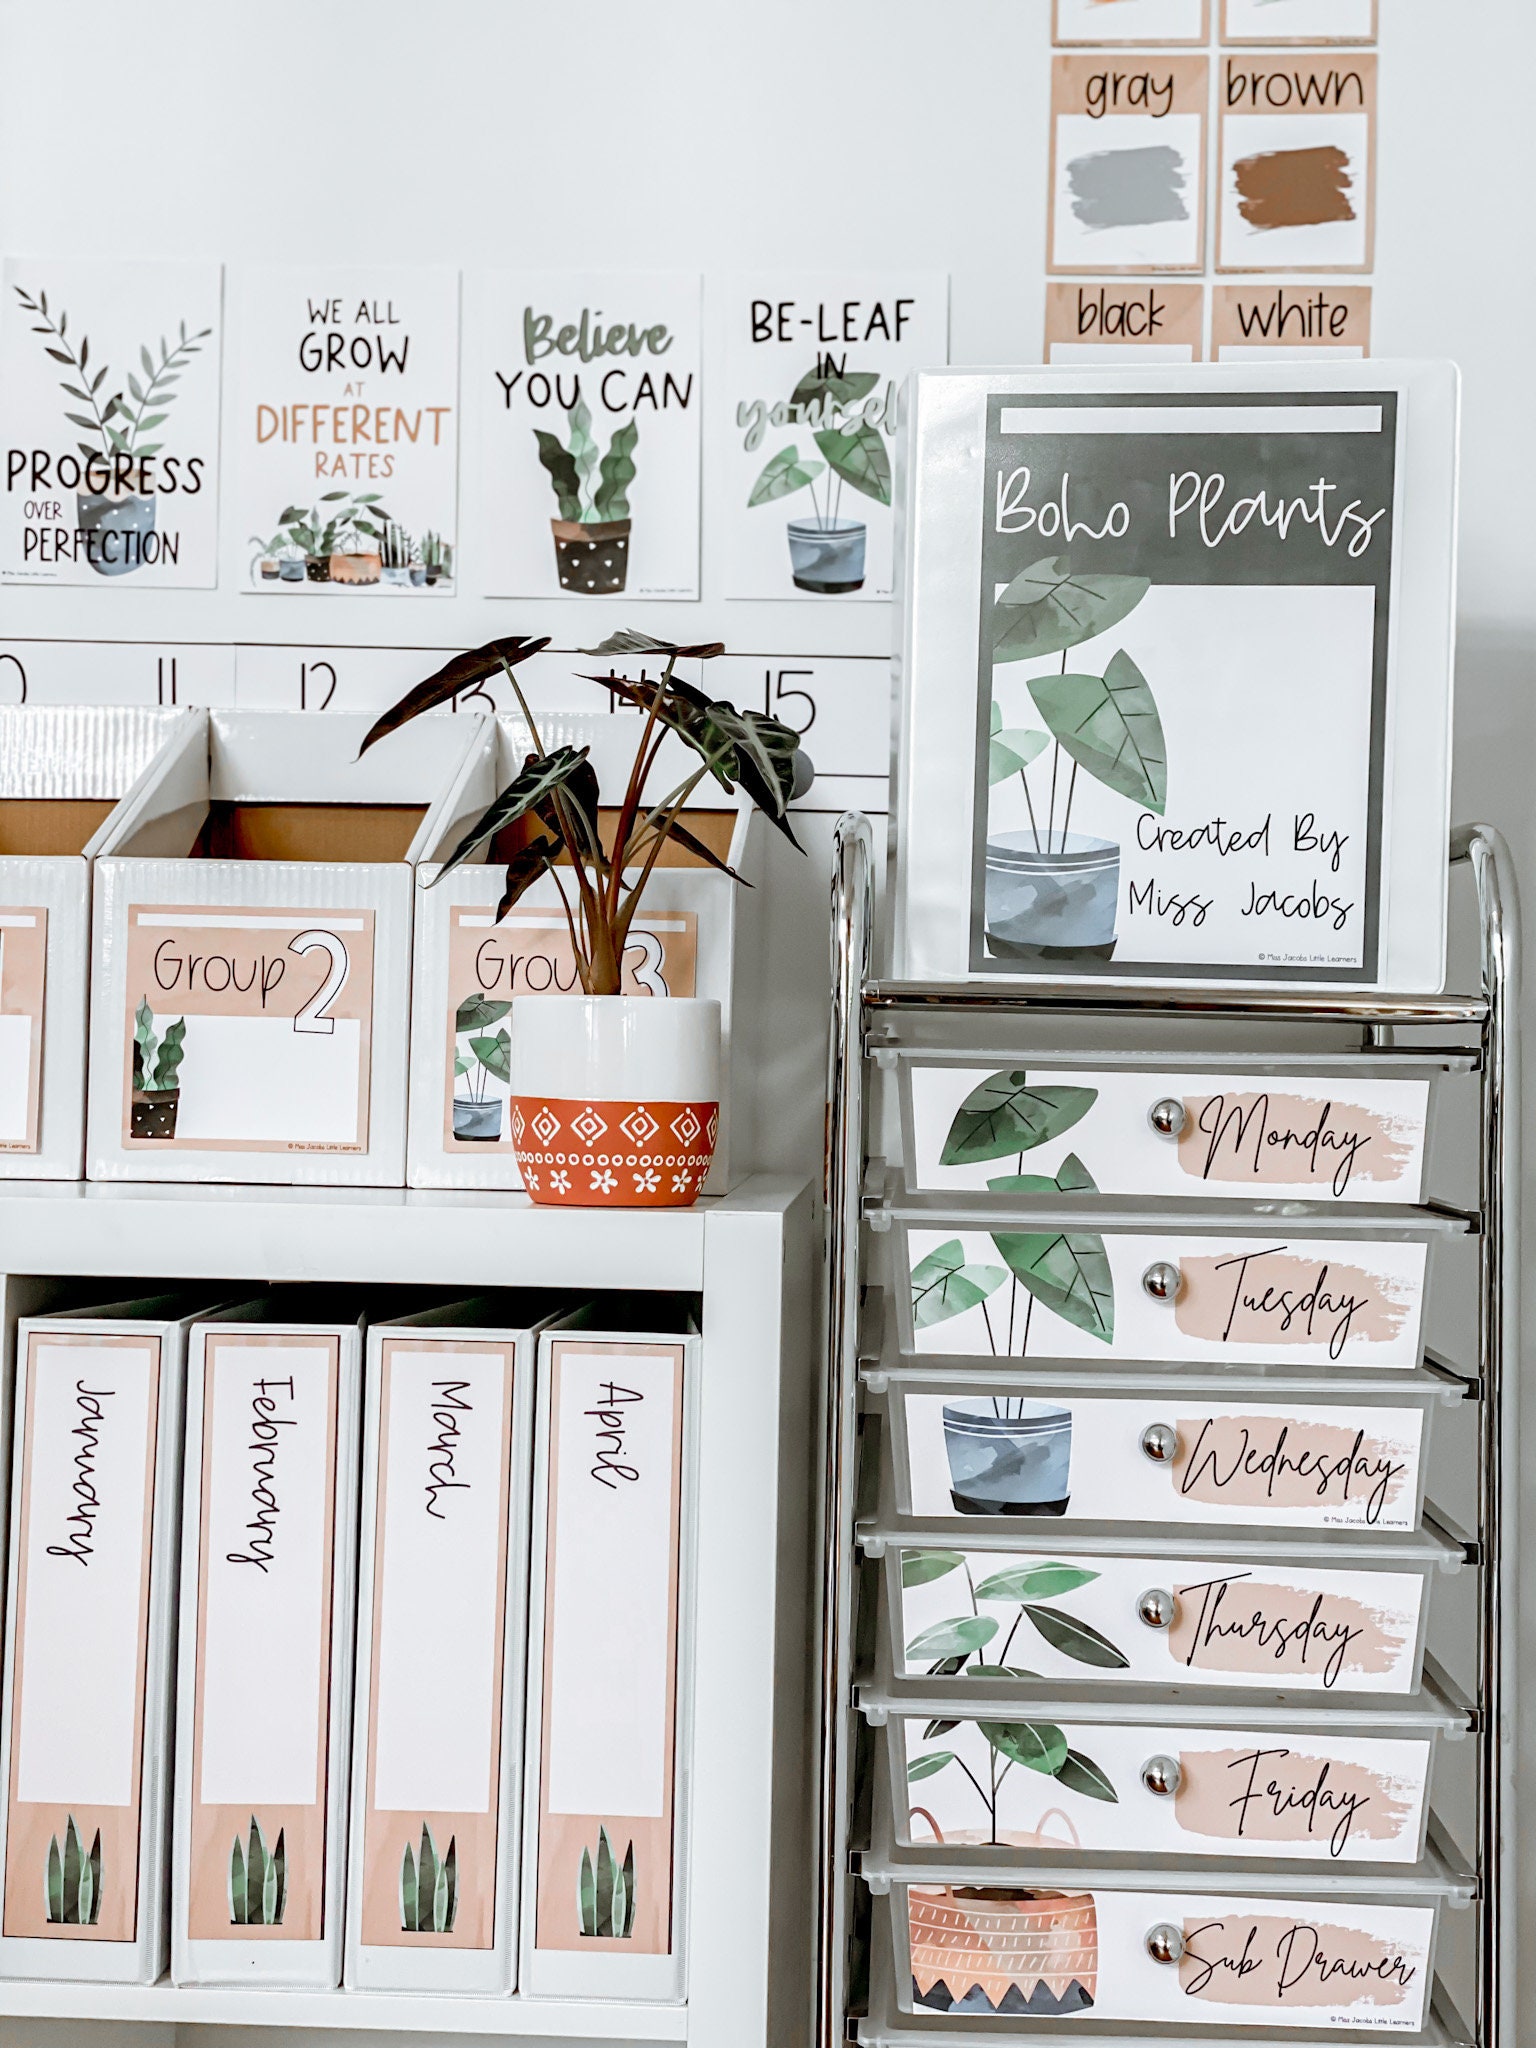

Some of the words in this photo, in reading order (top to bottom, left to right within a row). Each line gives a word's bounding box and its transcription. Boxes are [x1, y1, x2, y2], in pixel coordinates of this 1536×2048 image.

[1086, 72, 1173, 119] gray
[1227, 59, 1363, 106] brown
[308, 299, 342, 324] WE
[355, 300, 400, 324] ALL
[522, 306, 674, 366] Believe
[751, 299, 915, 343] BE-LEAF
[1078, 288, 1165, 337] black
[1237, 289, 1348, 338] white
[299, 332, 409, 374] GROW
[817, 351, 847, 380] IN
[344, 381, 365, 397] AT
[495, 371, 580, 411] YOU
[601, 369, 693, 413] CAN
[256, 404, 451, 446] DIFFERENT
[736, 380, 897, 452] yoursel
[8, 449, 205, 496] PROGRESS
[315, 451, 395, 479] RATES
[24, 501, 63, 520] OVER
[996, 466, 1130, 542] Boho
[1170, 471, 1386, 558] Plants
[24, 527, 180, 565] PERFECTION
[765, 669, 816, 735] 15
[1136, 813, 1271, 857] Created
[1294, 813, 1349, 872] By
[1129, 878, 1214, 928] Miss
[1241, 879, 1355, 931] Jacobs
[154, 939, 286, 1009] Group
[287, 929, 349, 1035] 2
[475, 938, 578, 992] Grou
[1267, 953, 1282, 961] Miss
[1283, 953, 1308, 962] Jacobs
[1309, 954, 1326, 962] Little
[1327, 955, 1358, 963] Learners
[1198, 1093, 1372, 1197] Monday
[1214, 1246, 1369, 1360] Tuesday
[424, 1381, 473, 1520] March
[583, 1381, 645, 1490] April
[46, 1379, 117, 1567] January
[226, 1375, 298, 1574] February
[1181, 1418, 1406, 1525] Wednesday
[1179, 1572, 1364, 1688] Thursday
[1227, 1749, 1370, 1858] Friday
[1184, 1922, 1263, 1996] Sub
[1276, 1924, 1417, 1998] Drawer
